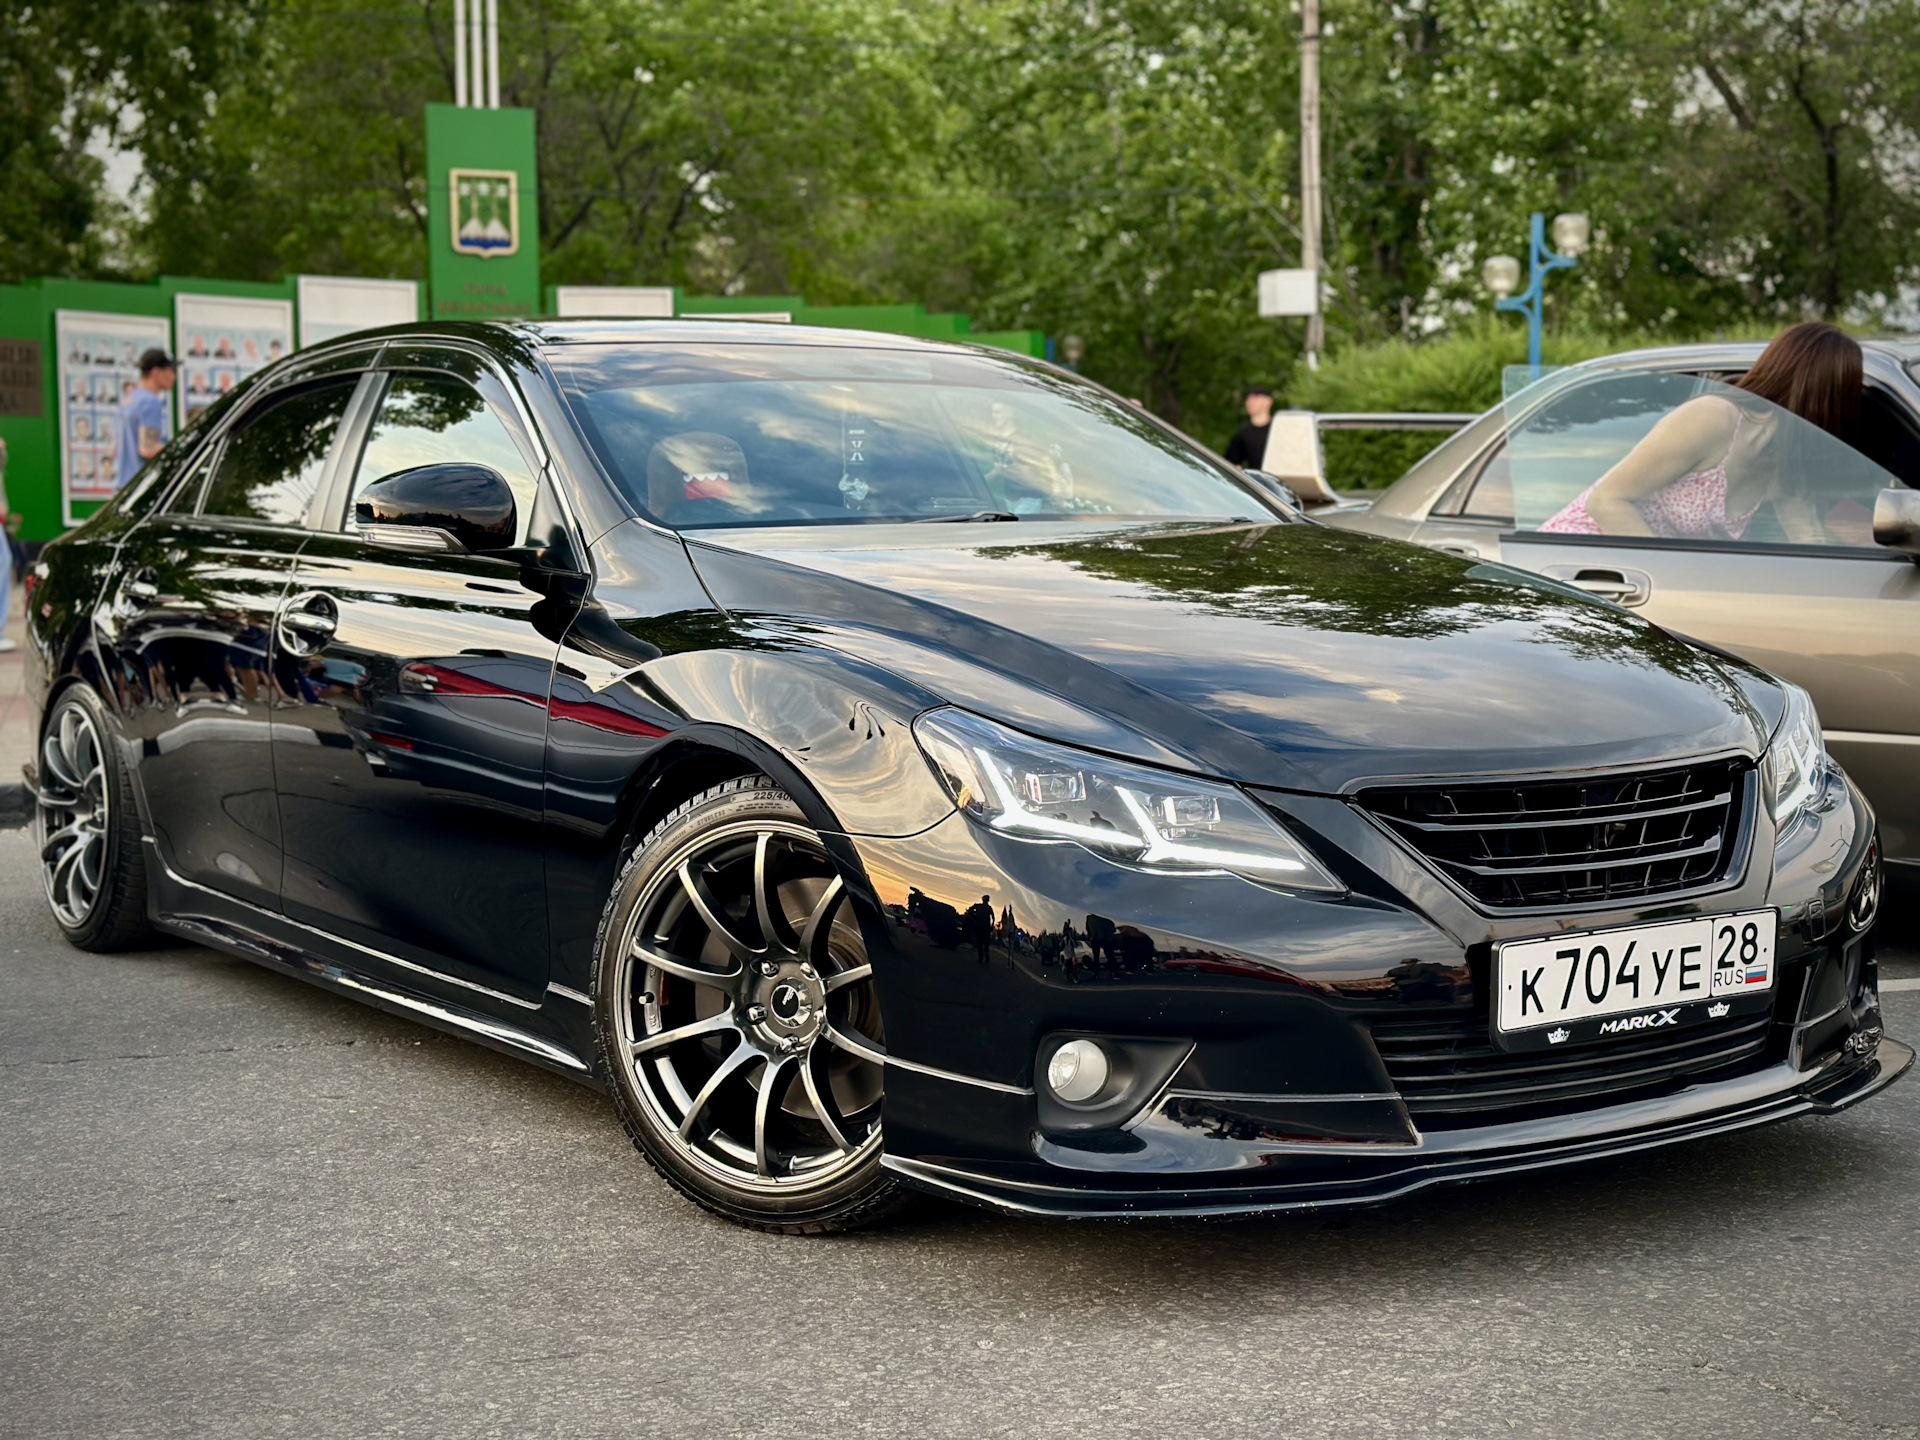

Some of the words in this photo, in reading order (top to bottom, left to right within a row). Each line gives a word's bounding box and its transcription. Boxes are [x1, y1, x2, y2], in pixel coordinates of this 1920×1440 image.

[753, 791, 792, 801] 225/40
[1717, 922, 1759, 970] 28
[1713, 969, 1744, 988] RUS
